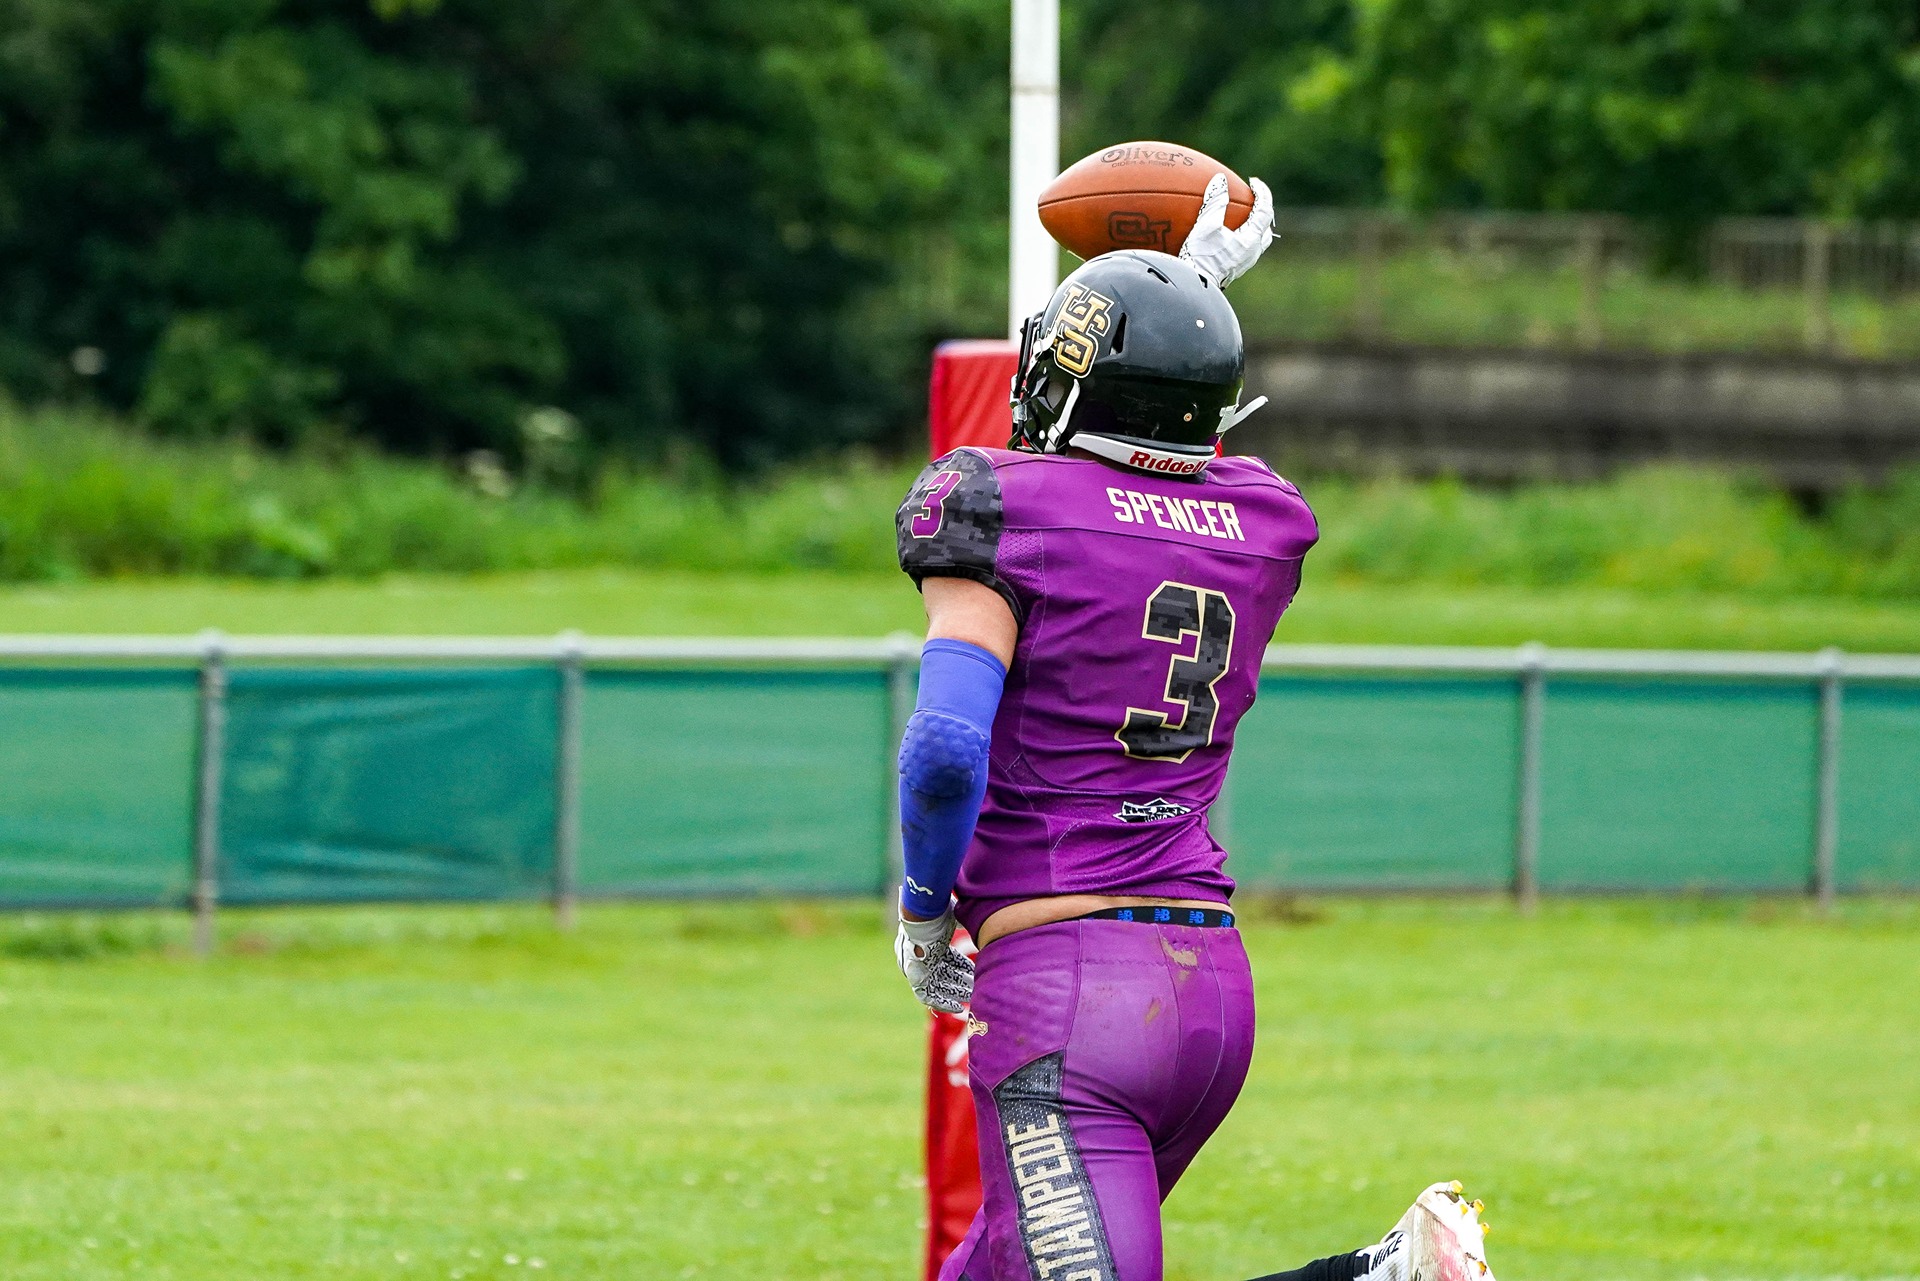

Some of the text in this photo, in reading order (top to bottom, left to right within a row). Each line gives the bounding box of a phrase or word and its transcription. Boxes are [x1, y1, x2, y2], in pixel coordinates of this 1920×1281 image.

[1101, 147, 1194, 167] Oliver's
[1129, 451, 1207, 474] Riddell
[910, 471, 962, 539] 3
[1106, 487, 1245, 542] SPENCER
[1114, 580, 1236, 764] 3
[1371, 1233, 1403, 1271] NIKE
